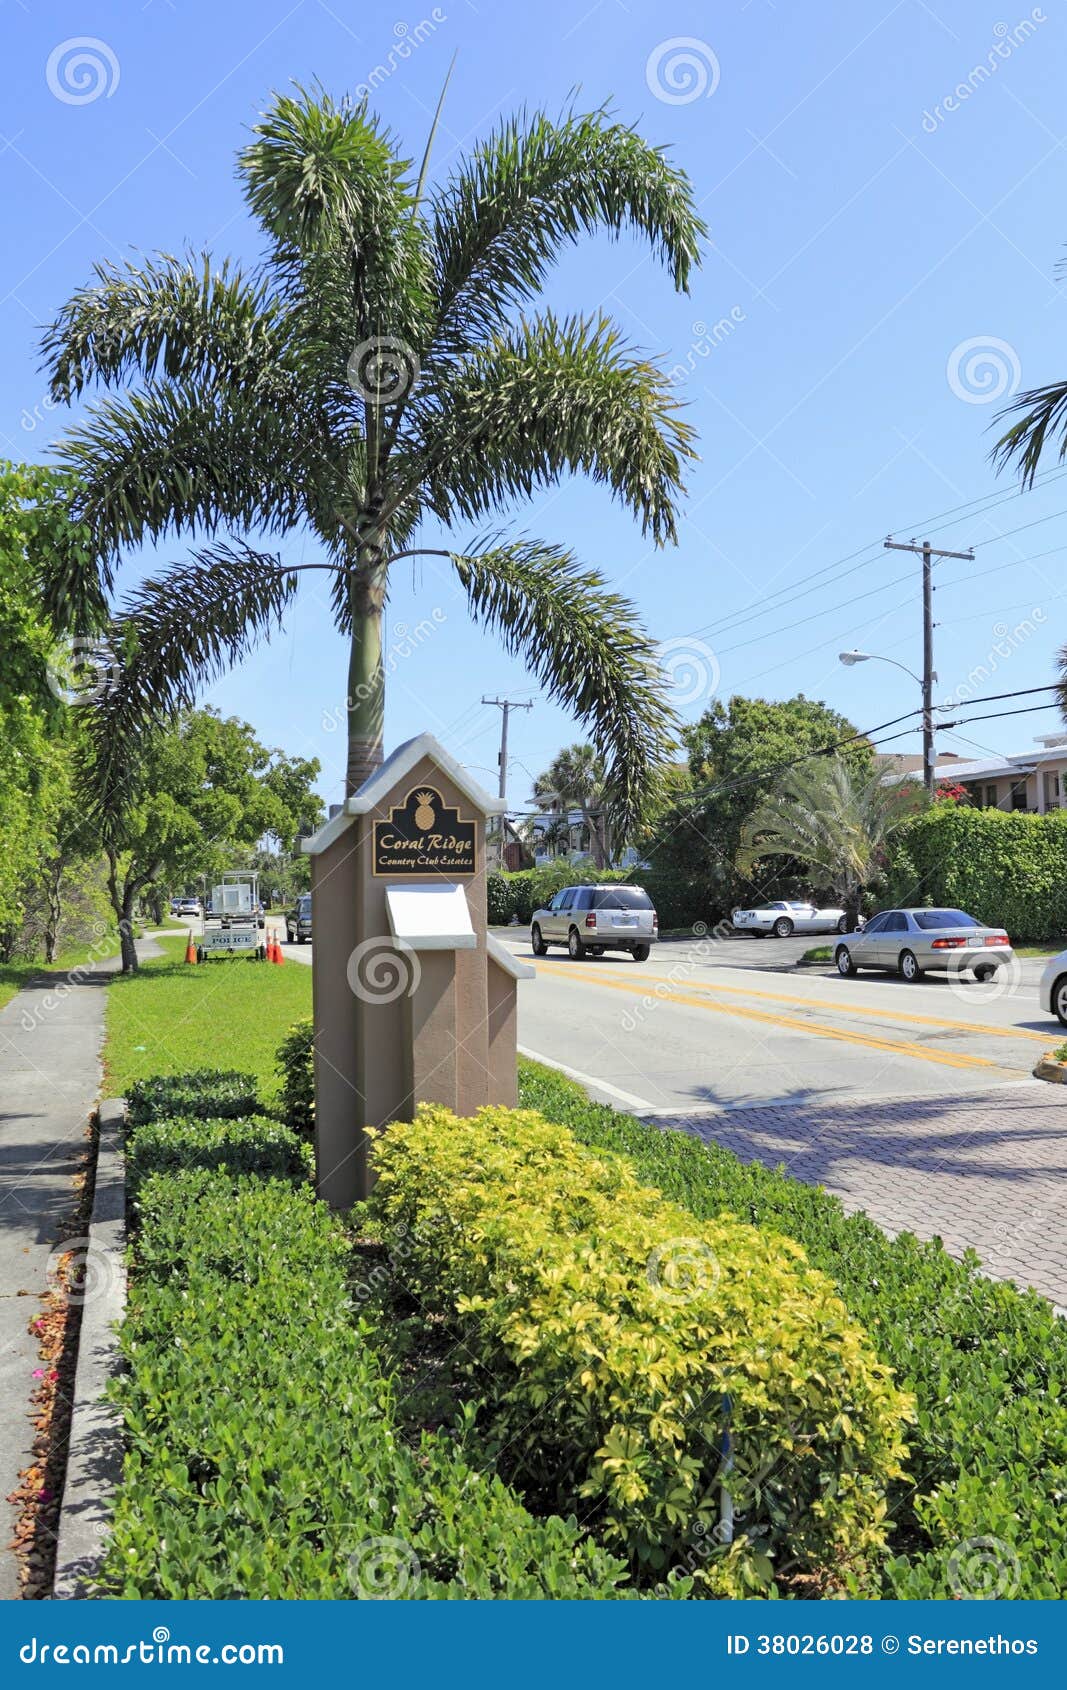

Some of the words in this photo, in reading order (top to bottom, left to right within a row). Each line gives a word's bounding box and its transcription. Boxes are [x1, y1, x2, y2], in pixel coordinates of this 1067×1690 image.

[380, 834, 425, 850] Coral
[426, 834, 472, 854] Ridge
[379, 856, 415, 869] Country
[416, 855, 439, 866] Club
[440, 855, 473, 866] Estates
[211, 936, 252, 944] POLICE
